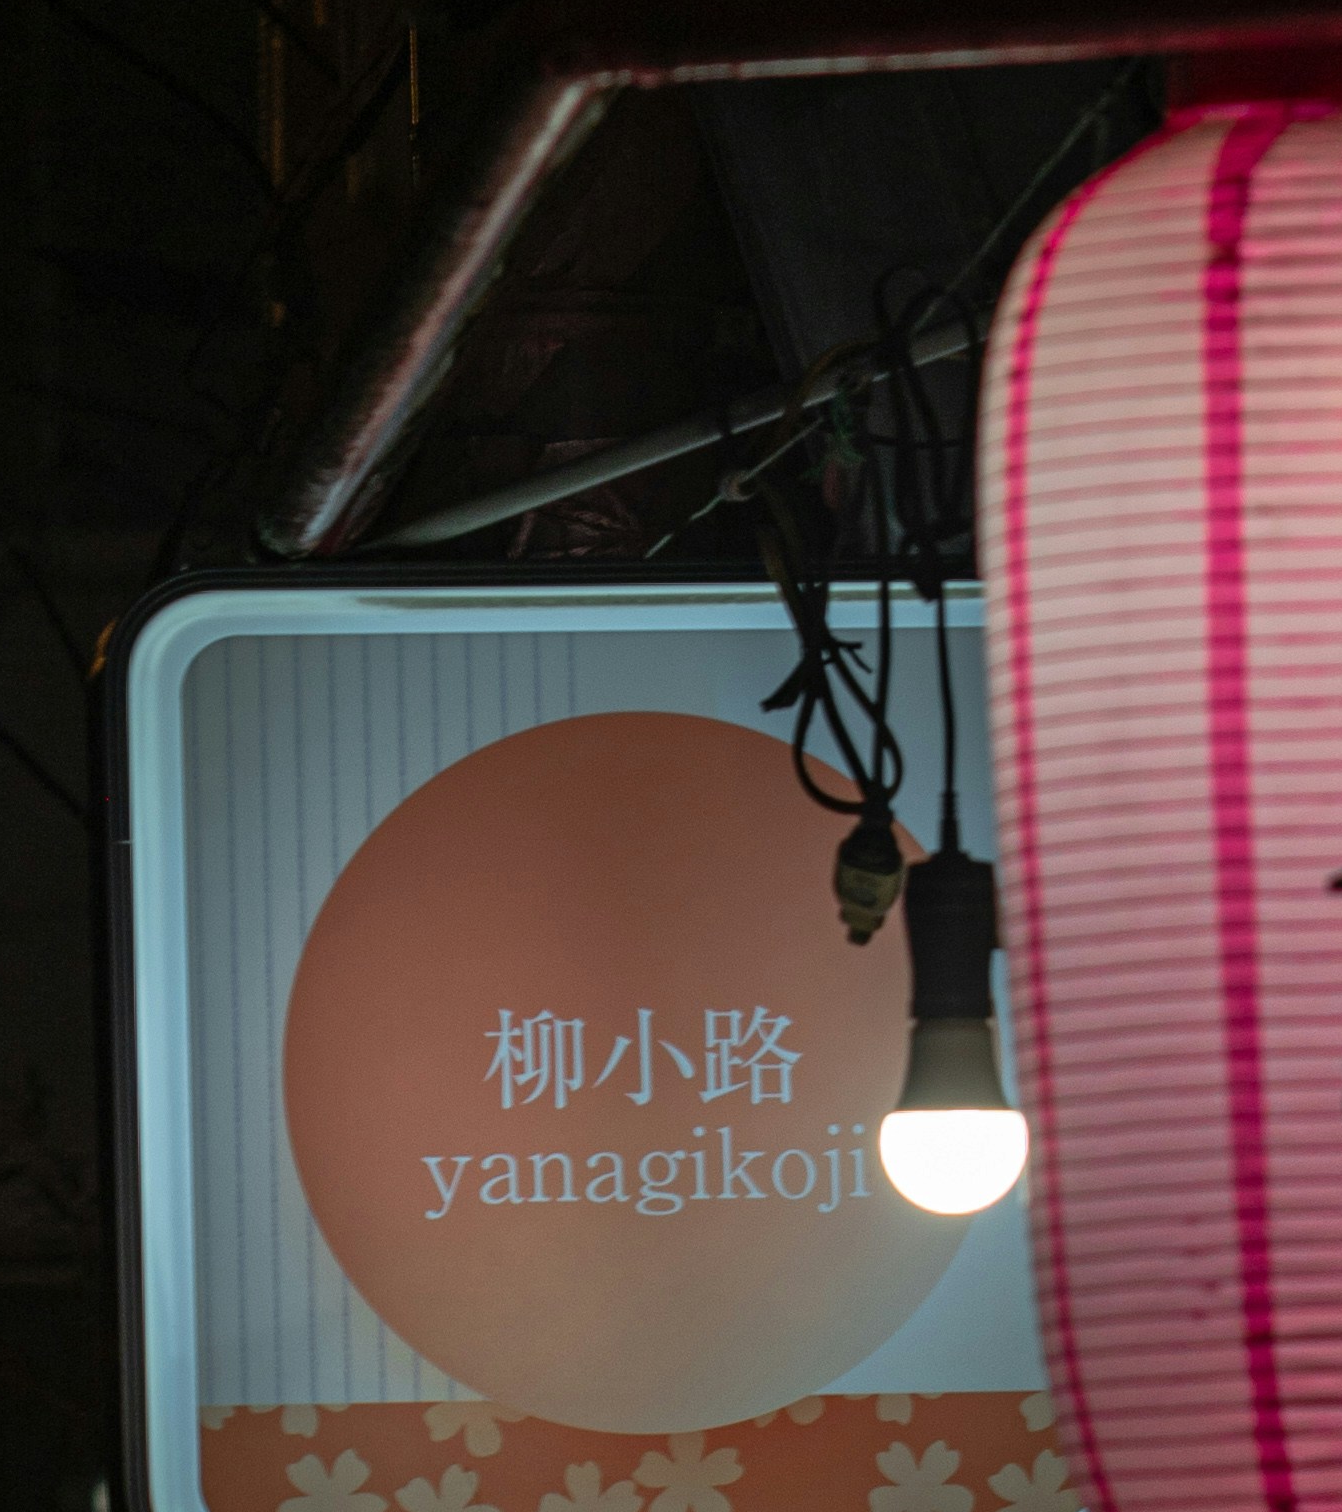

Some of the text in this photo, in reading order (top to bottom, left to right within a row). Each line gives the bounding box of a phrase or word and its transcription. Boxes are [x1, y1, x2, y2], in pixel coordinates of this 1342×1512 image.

[482, 1004, 801, 1110] 柳小路
[420, 1124, 872, 1219] yanagikoji
